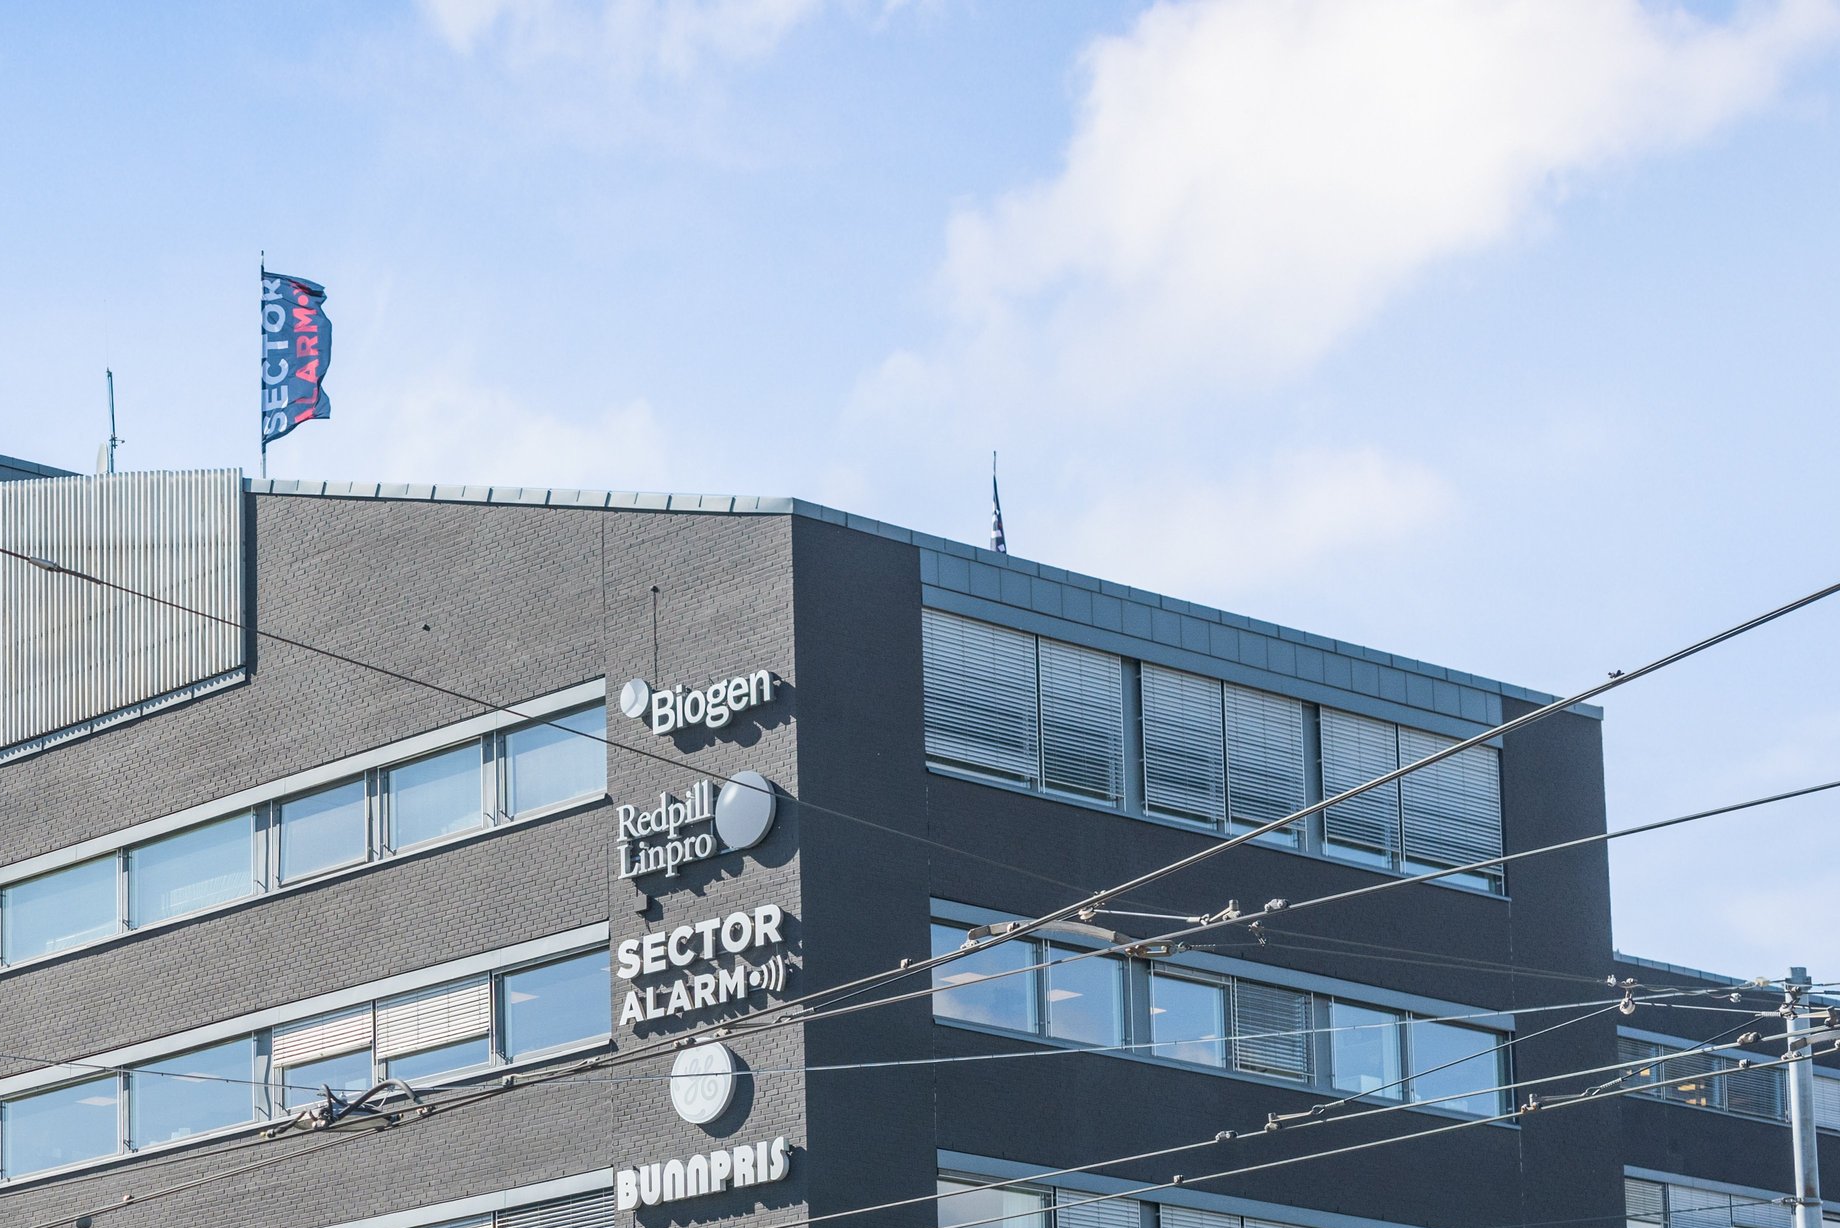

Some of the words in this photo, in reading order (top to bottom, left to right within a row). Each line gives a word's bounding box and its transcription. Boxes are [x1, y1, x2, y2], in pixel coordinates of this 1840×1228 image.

[261, 278, 289, 435] SECTOR
[652, 669, 774, 735] Biogen
[616, 779, 713, 842] Redpill
[617, 833, 716, 880] Linpro
[616, 903, 784, 980] SECTOR
[618, 965, 747, 1026] ALARM
[617, 1136, 788, 1211] BUNNPRIS
